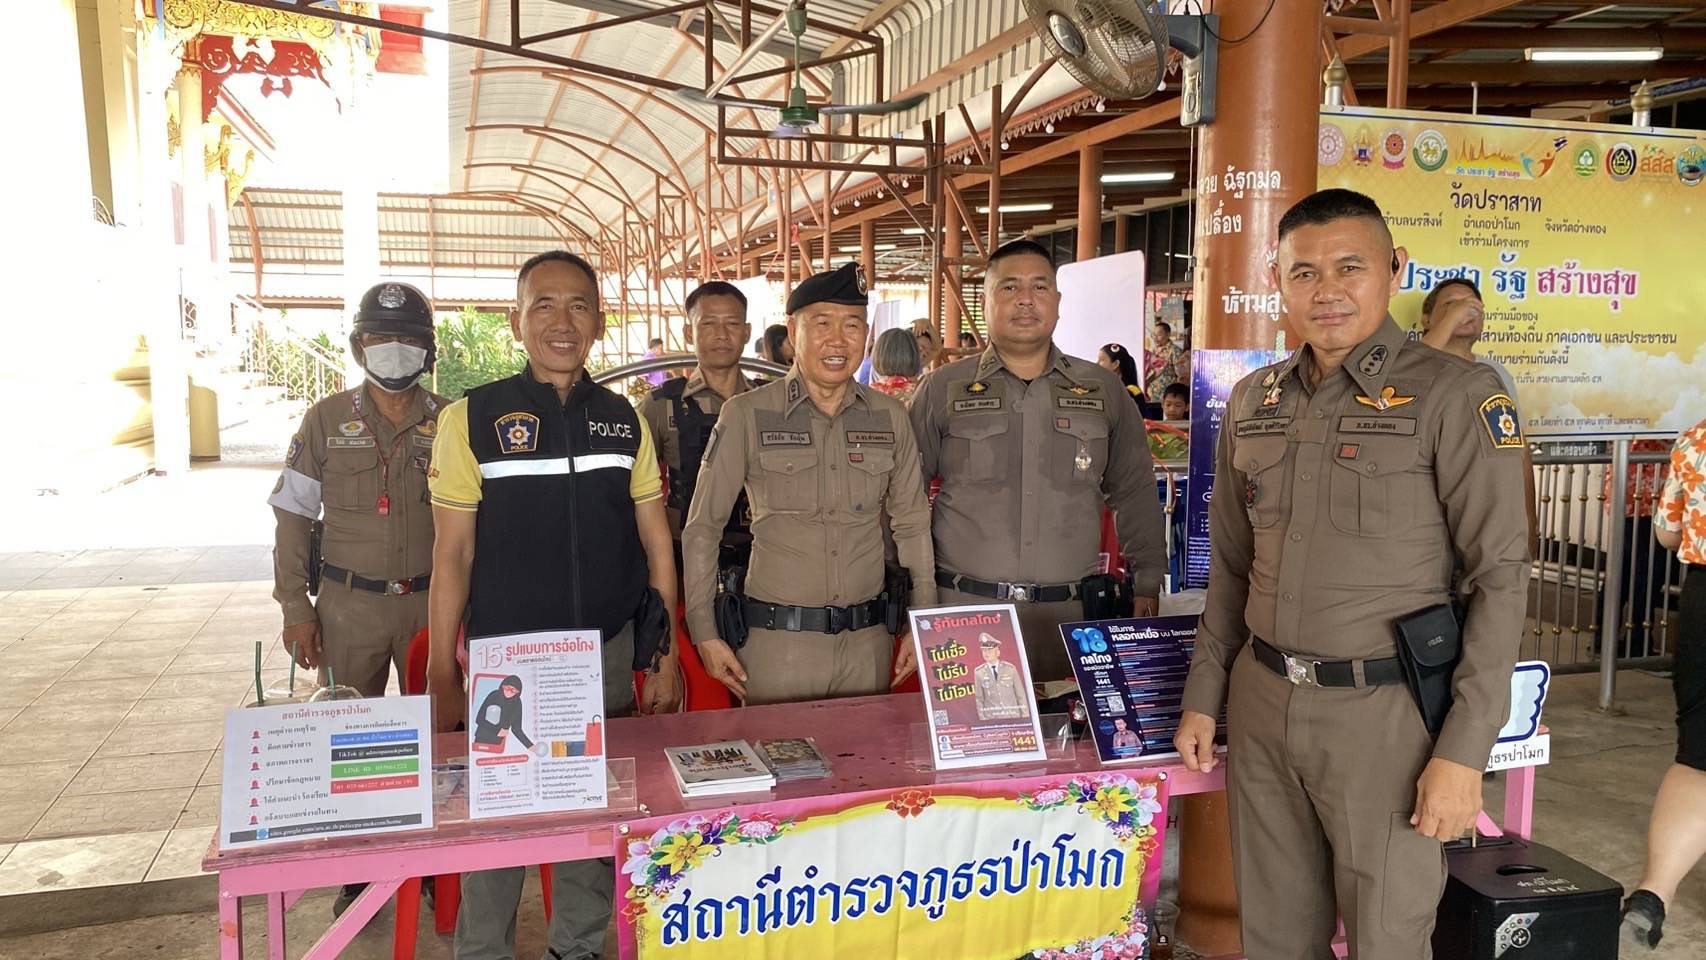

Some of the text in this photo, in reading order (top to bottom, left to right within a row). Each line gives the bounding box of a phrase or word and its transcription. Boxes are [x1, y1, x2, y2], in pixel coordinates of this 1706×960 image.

[1449, 181, 1542, 213] วัดปราสาท
[1463, 214, 1521, 232] อำเภอป่าโมก
[1544, 217, 1607, 235] จังหวัดอ่างทอง
[1459, 231, 1530, 249] เข้าร่วมโครงการ
[1491, 252, 1528, 299] รัฐ
[1536, 261, 1638, 311] สร้างสุข
[1221, 286, 1289, 322] ห้ามสู
[1545, 329, 1602, 345] ภาคเอกชน
[1604, 331, 1677, 345] และประชาชน
[589, 420, 634, 440] POLICE
[505, 638, 595, 662] รูปแบบการฉ้อโกง
[930, 639, 968, 663] ไม่เชื่อ
[1071, 627, 1108, 653] 18
[477, 643, 503, 669] 15
[1080, 652, 1113, 666] กลโกง
[936, 663, 969, 681] ไม่รีบ
[936, 684, 976, 702] ไม่โอน
[1013, 736, 1037, 746] 1441
[660, 832, 1128, 947] สถานีตำรวจภูธรป่าโมก
